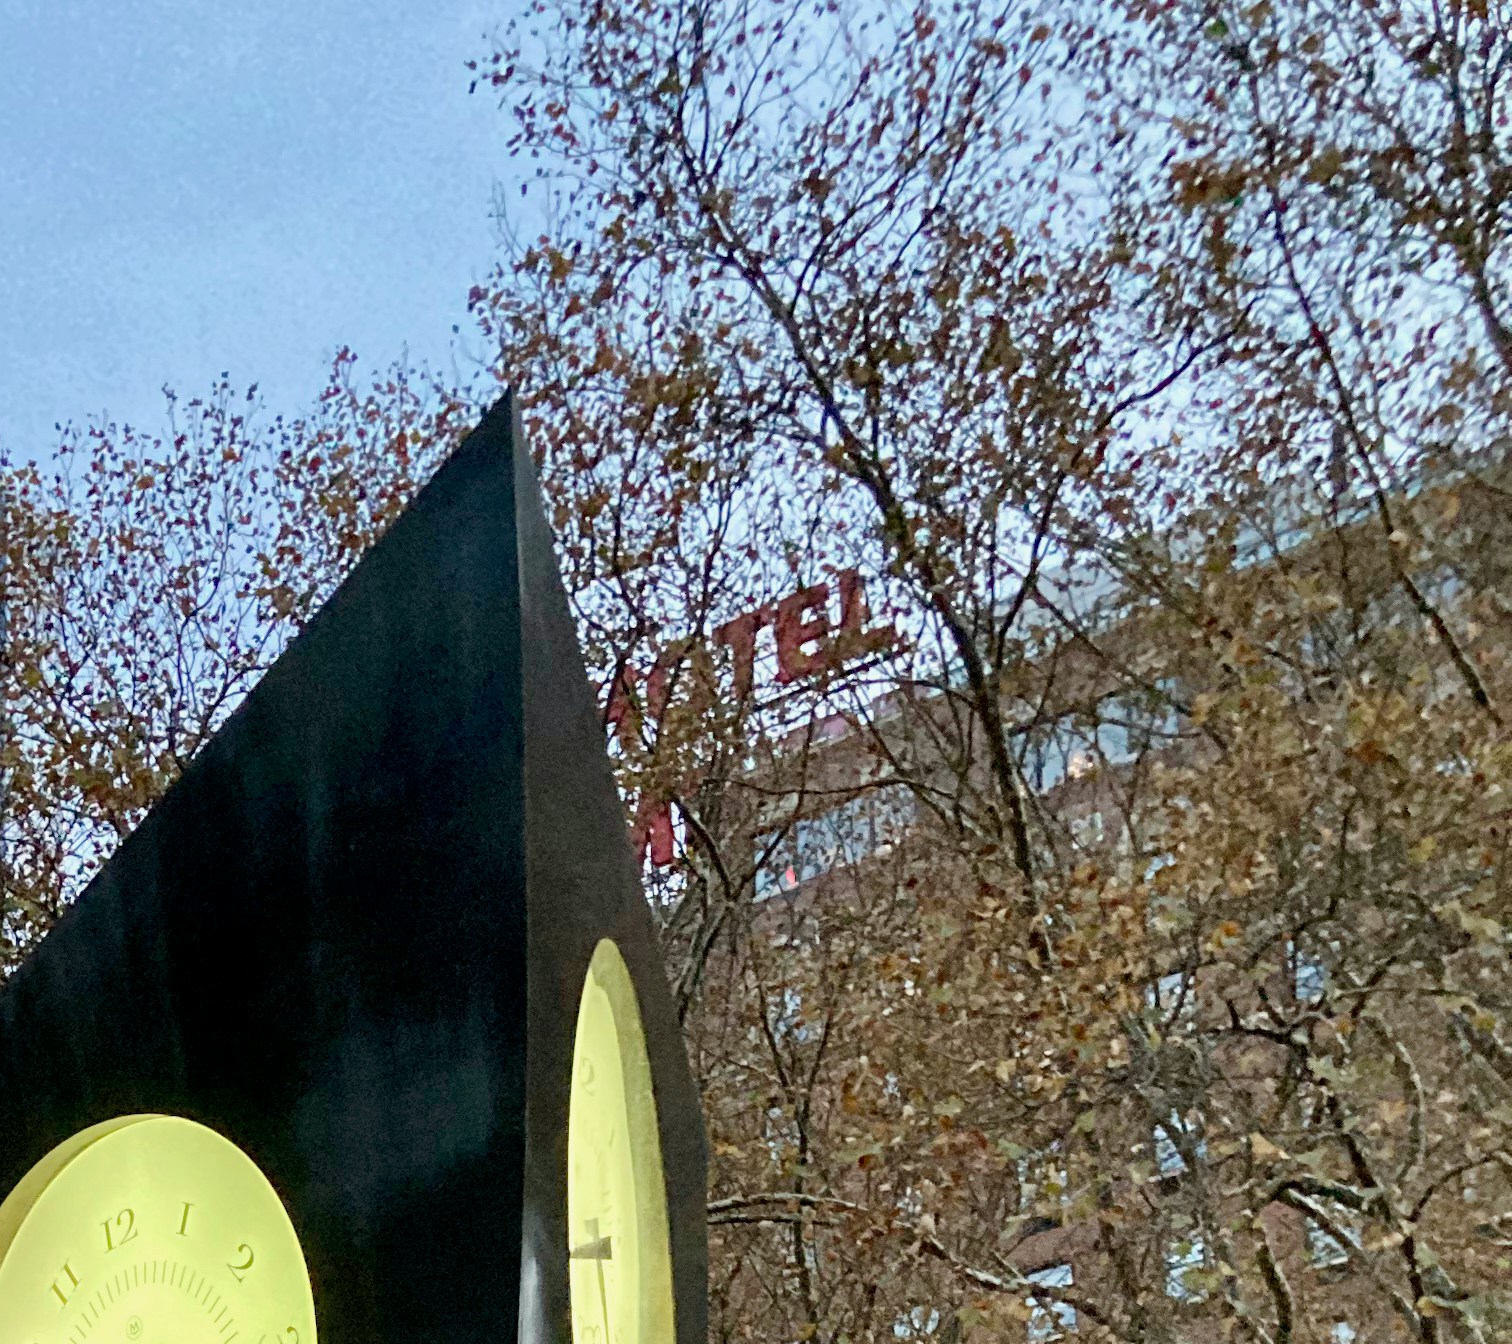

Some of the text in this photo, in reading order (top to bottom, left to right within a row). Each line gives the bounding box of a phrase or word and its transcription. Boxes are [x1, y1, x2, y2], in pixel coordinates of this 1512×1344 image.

[99, 1207, 139, 1254] 12
[175, 1201, 194, 1237] 1
[48, 1258, 83, 1310] 11
[226, 1243, 255, 1283] 2
